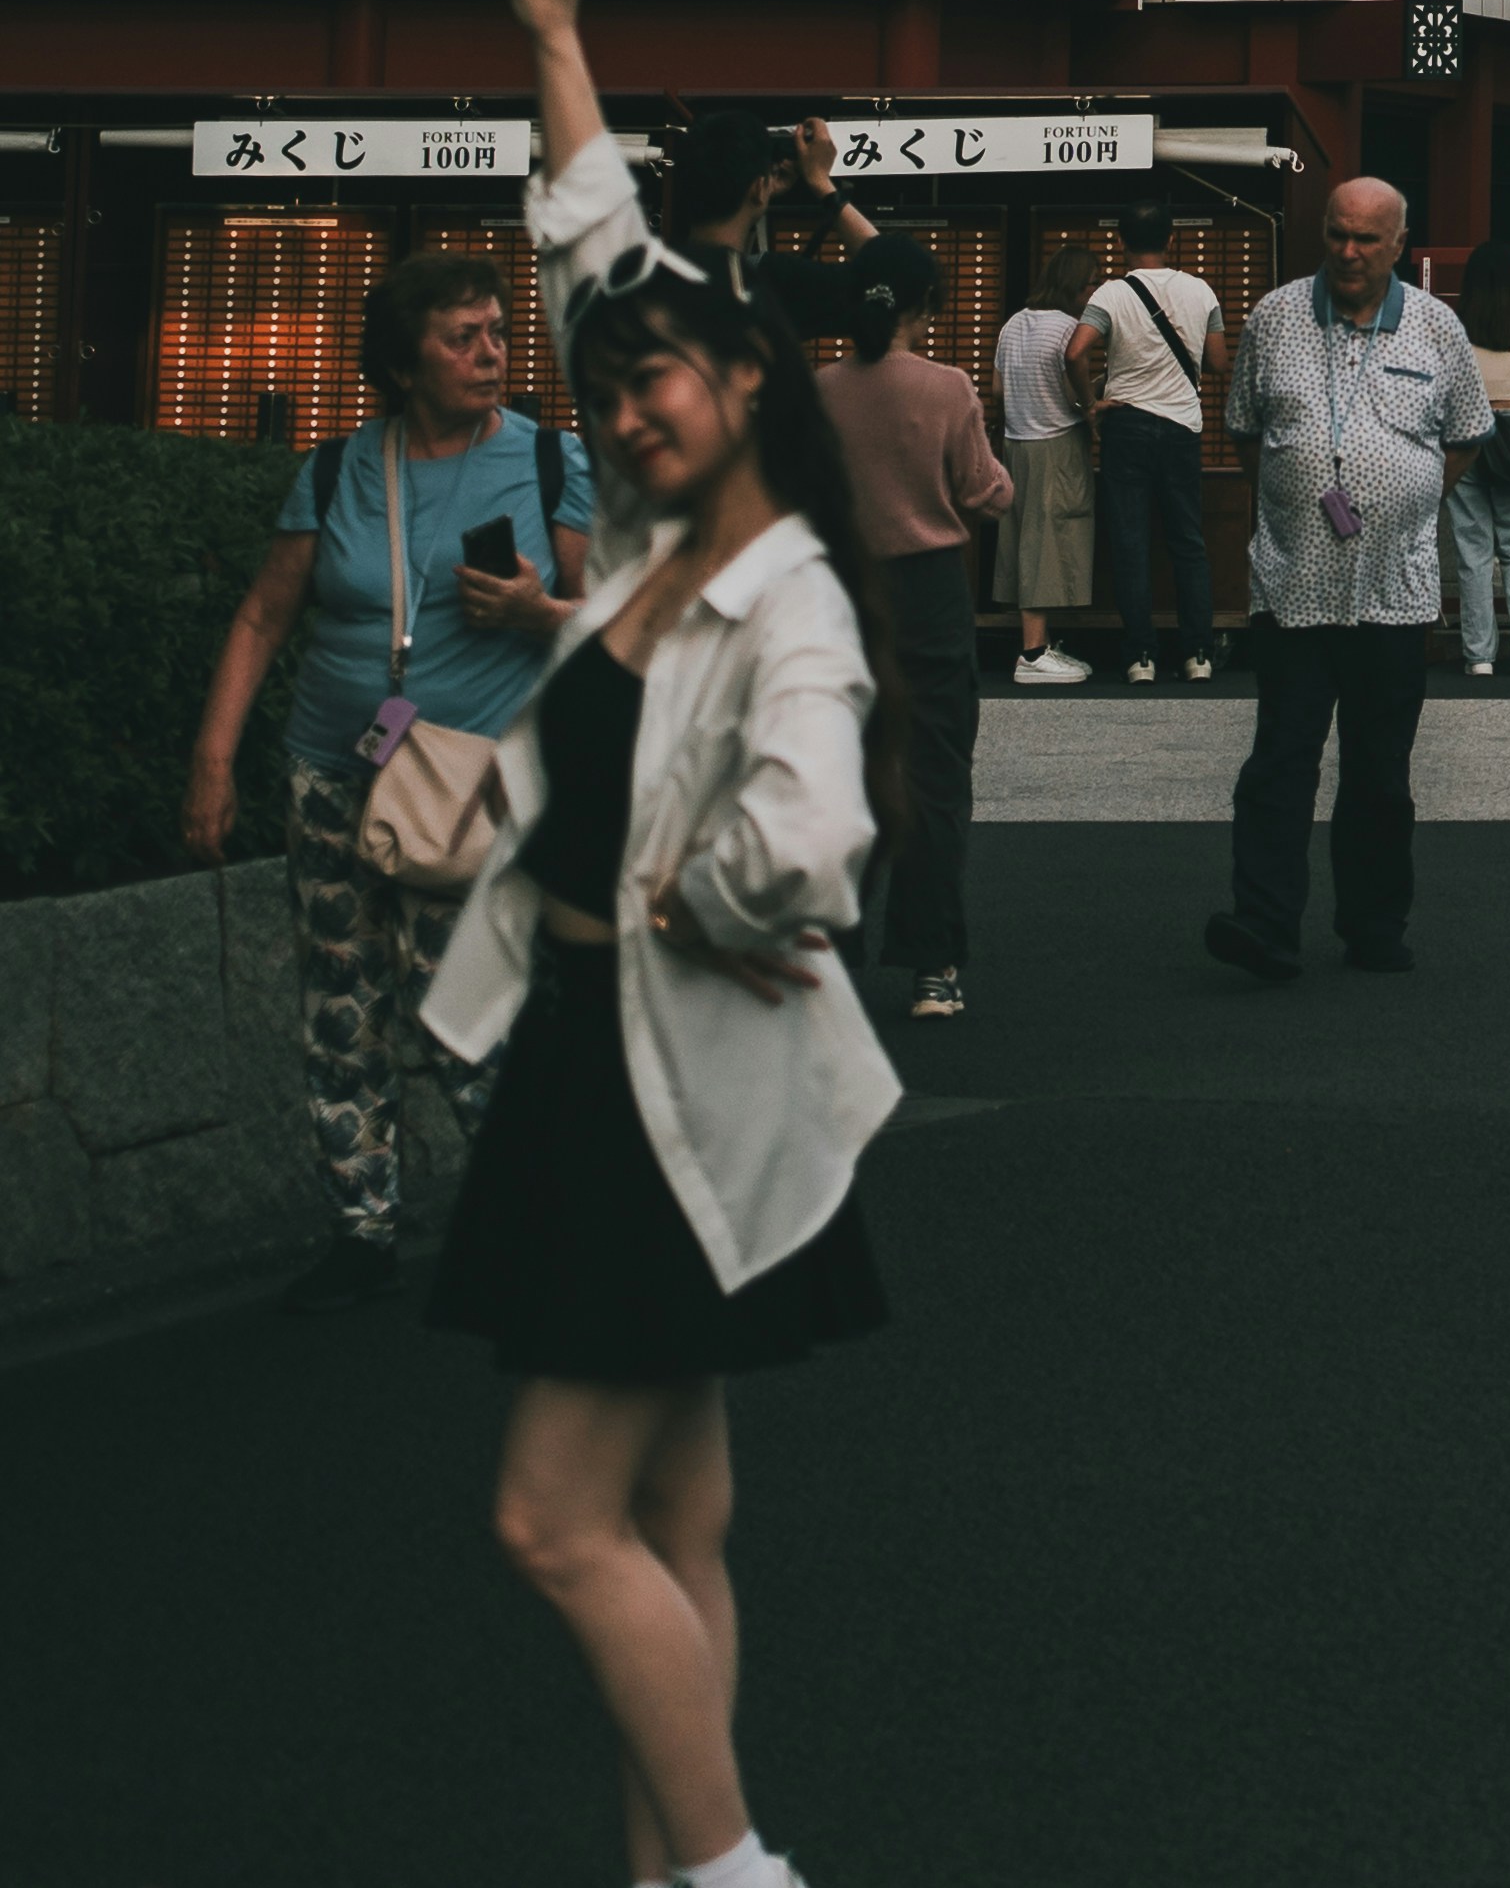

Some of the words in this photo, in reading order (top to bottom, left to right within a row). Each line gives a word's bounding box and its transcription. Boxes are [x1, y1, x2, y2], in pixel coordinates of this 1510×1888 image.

[422, 131, 497, 143] FORTUNE
[1043, 125, 1119, 139] FORTUNE
[225, 130, 367, 171] みくじ
[420, 147, 496, 169] 100円
[843, 129, 986, 170] みくじ
[1042, 140, 1118, 164] 100円
